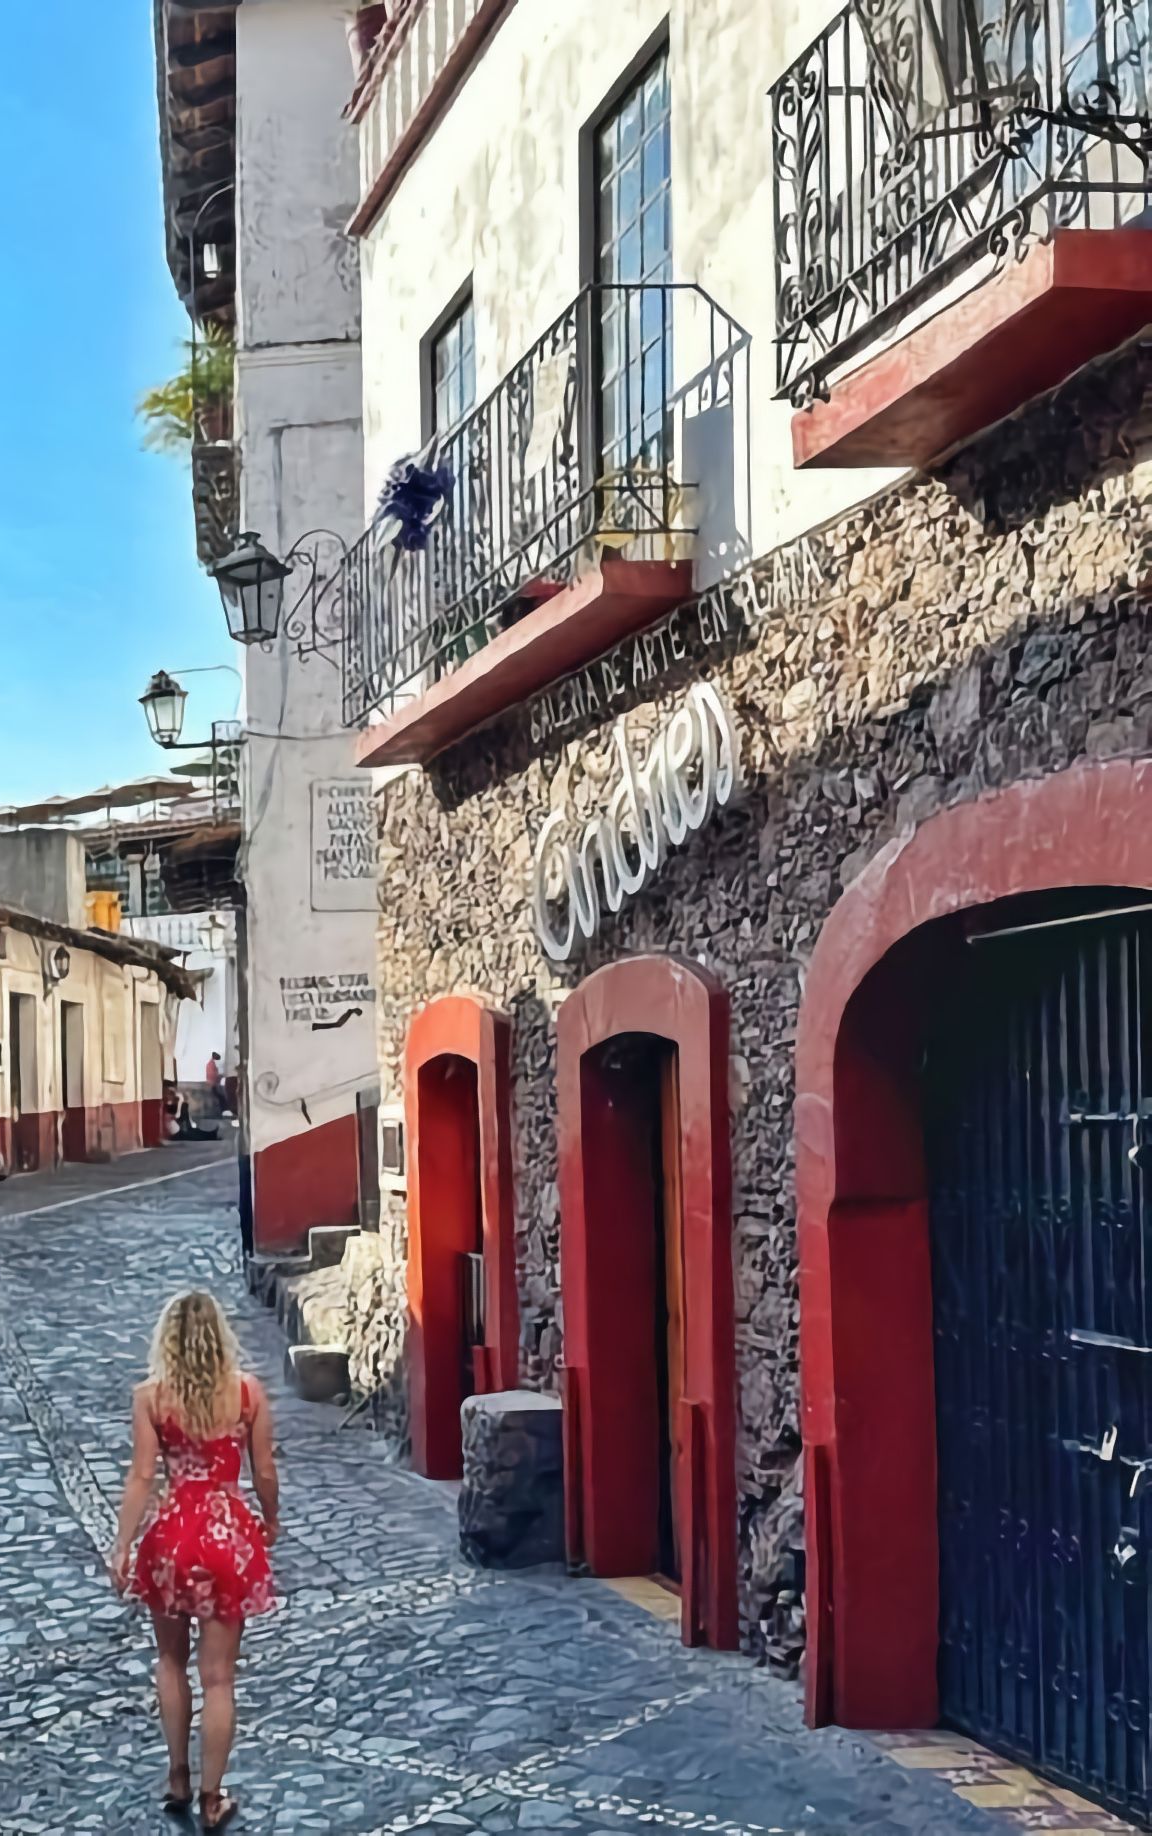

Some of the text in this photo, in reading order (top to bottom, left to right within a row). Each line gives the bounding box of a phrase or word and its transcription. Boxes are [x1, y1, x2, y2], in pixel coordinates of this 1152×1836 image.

[602, 653, 627, 702] DE
[632, 609, 687, 687] ARTE
[696, 588, 730, 645] EN
